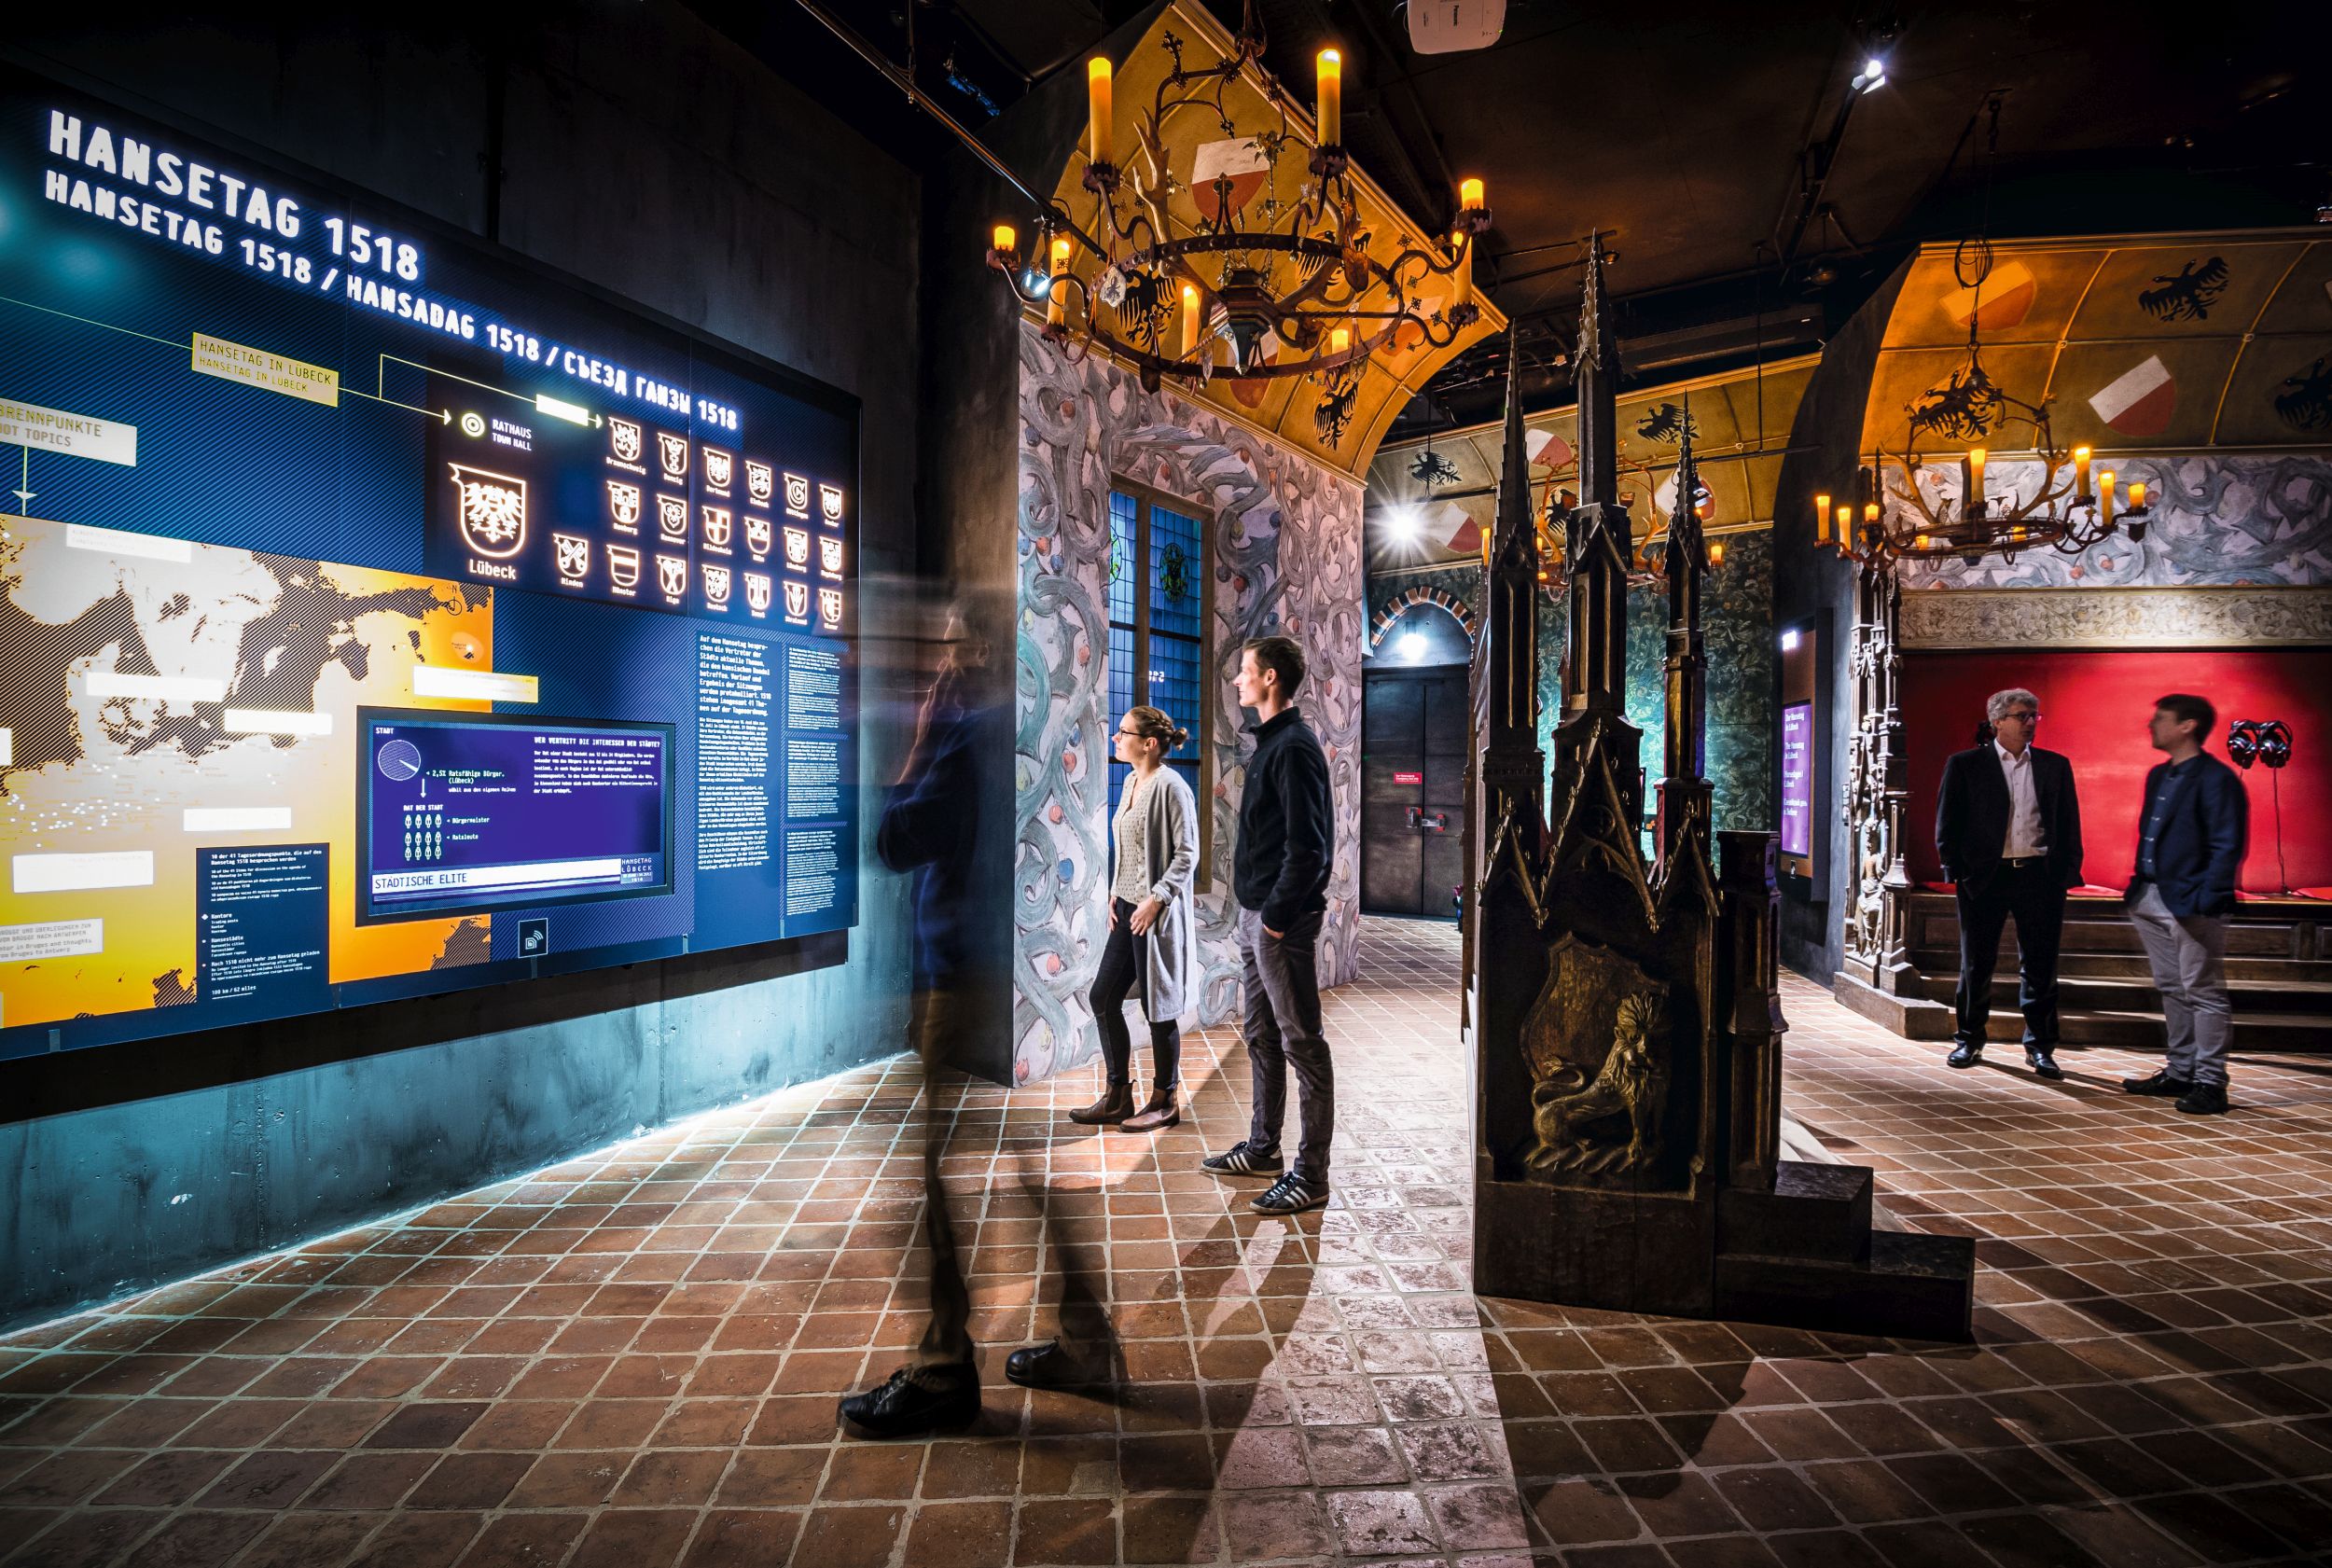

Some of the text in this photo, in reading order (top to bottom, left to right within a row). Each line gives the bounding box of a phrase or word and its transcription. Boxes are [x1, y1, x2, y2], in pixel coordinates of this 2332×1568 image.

[49, 109, 418, 281] HANSETAG 1518
[45, 169, 223, 255] HANSETAG
[240, 239, 312, 284] 1518
[347, 273, 475, 340] HANSADAG
[486, 324, 539, 362] 1518
[200, 356, 251, 377] HANSETAG
[256, 371, 267, 382] IN
[201, 340, 331, 385] HANSETAG IN LÜBECK
[563, 351, 628, 396] СЪЕЗД
[698, 400, 737, 430] 1518
[0, 424, 71, 447] OT TOPICS
[493, 419, 532, 439] RATHAUS
[493, 433, 532, 451] TOWN HALL
[470, 559, 516, 580] Lübeck
[452, 585, 457, 593] N
[561, 577, 583, 588] Minden
[722, 638, 746, 648] Hansetag
[725, 647, 751, 656] Vertreter
[700, 652, 719, 661] Städte
[720, 656, 744, 664] aktuelle
[376, 873, 467, 889] STÄDTISCHE ELITE
